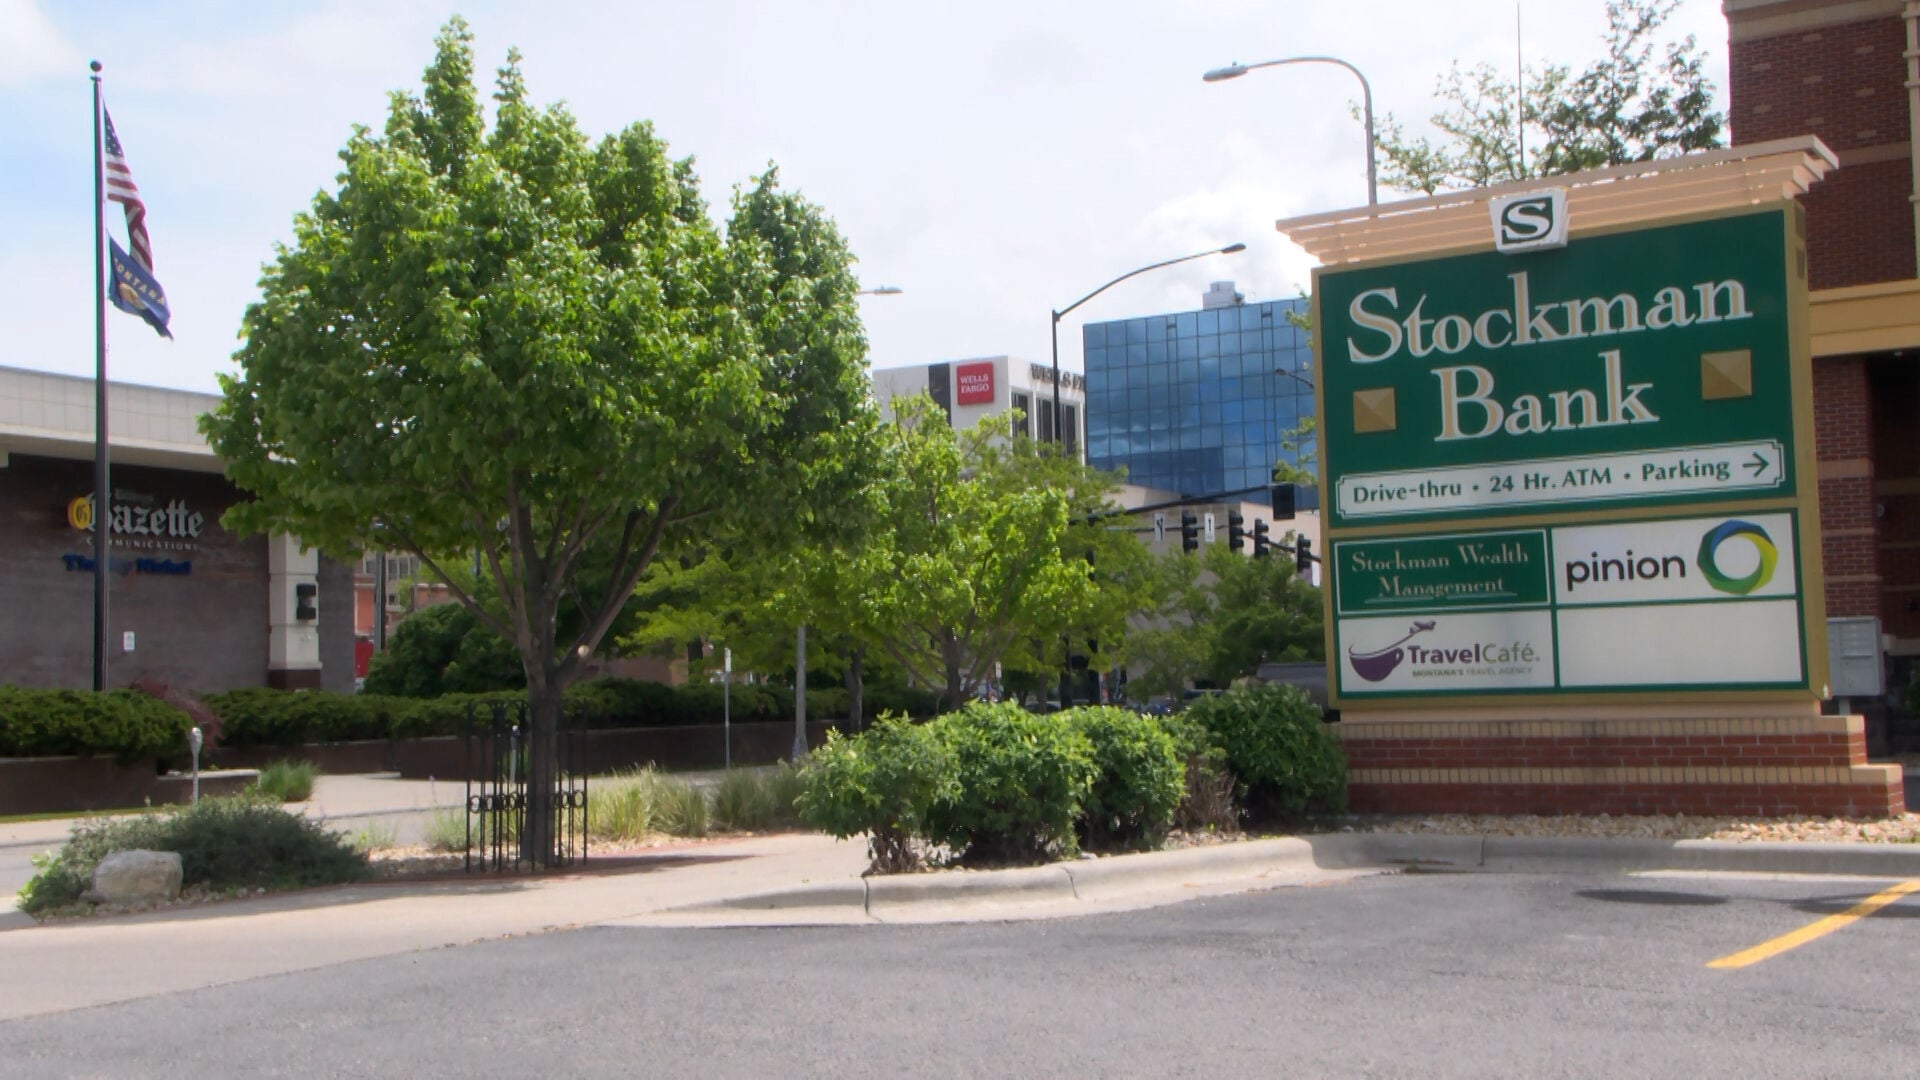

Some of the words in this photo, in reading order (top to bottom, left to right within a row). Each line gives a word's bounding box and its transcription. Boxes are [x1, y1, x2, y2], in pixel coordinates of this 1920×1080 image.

[1503, 201, 1550, 240] S
[1347, 271, 1753, 364] Stockman
[960, 373, 989, 384] WELLS
[960, 383, 990, 394] FARGO
[1431, 349, 1660, 443] Bank
[1353, 480, 1462, 504] Drive-thru
[1490, 475, 1514, 493] 24
[1524, 472, 1556, 490] Hr.
[1562, 467, 1612, 487] ATM
[1641, 458, 1731, 481] Parking
[86, 537, 199, 551] CMUNICATIONS
[1351, 549, 1450, 572] Stockman
[1457, 541, 1529, 565] Wealth
[1566, 549, 1686, 592] pinion
[1378, 575, 1504, 598] Management
[1412, 668, 1464, 678] MONTANA'S
[1465, 668, 1496, 676] TRAVEL
[1499, 667, 1532, 675] AGENCY
